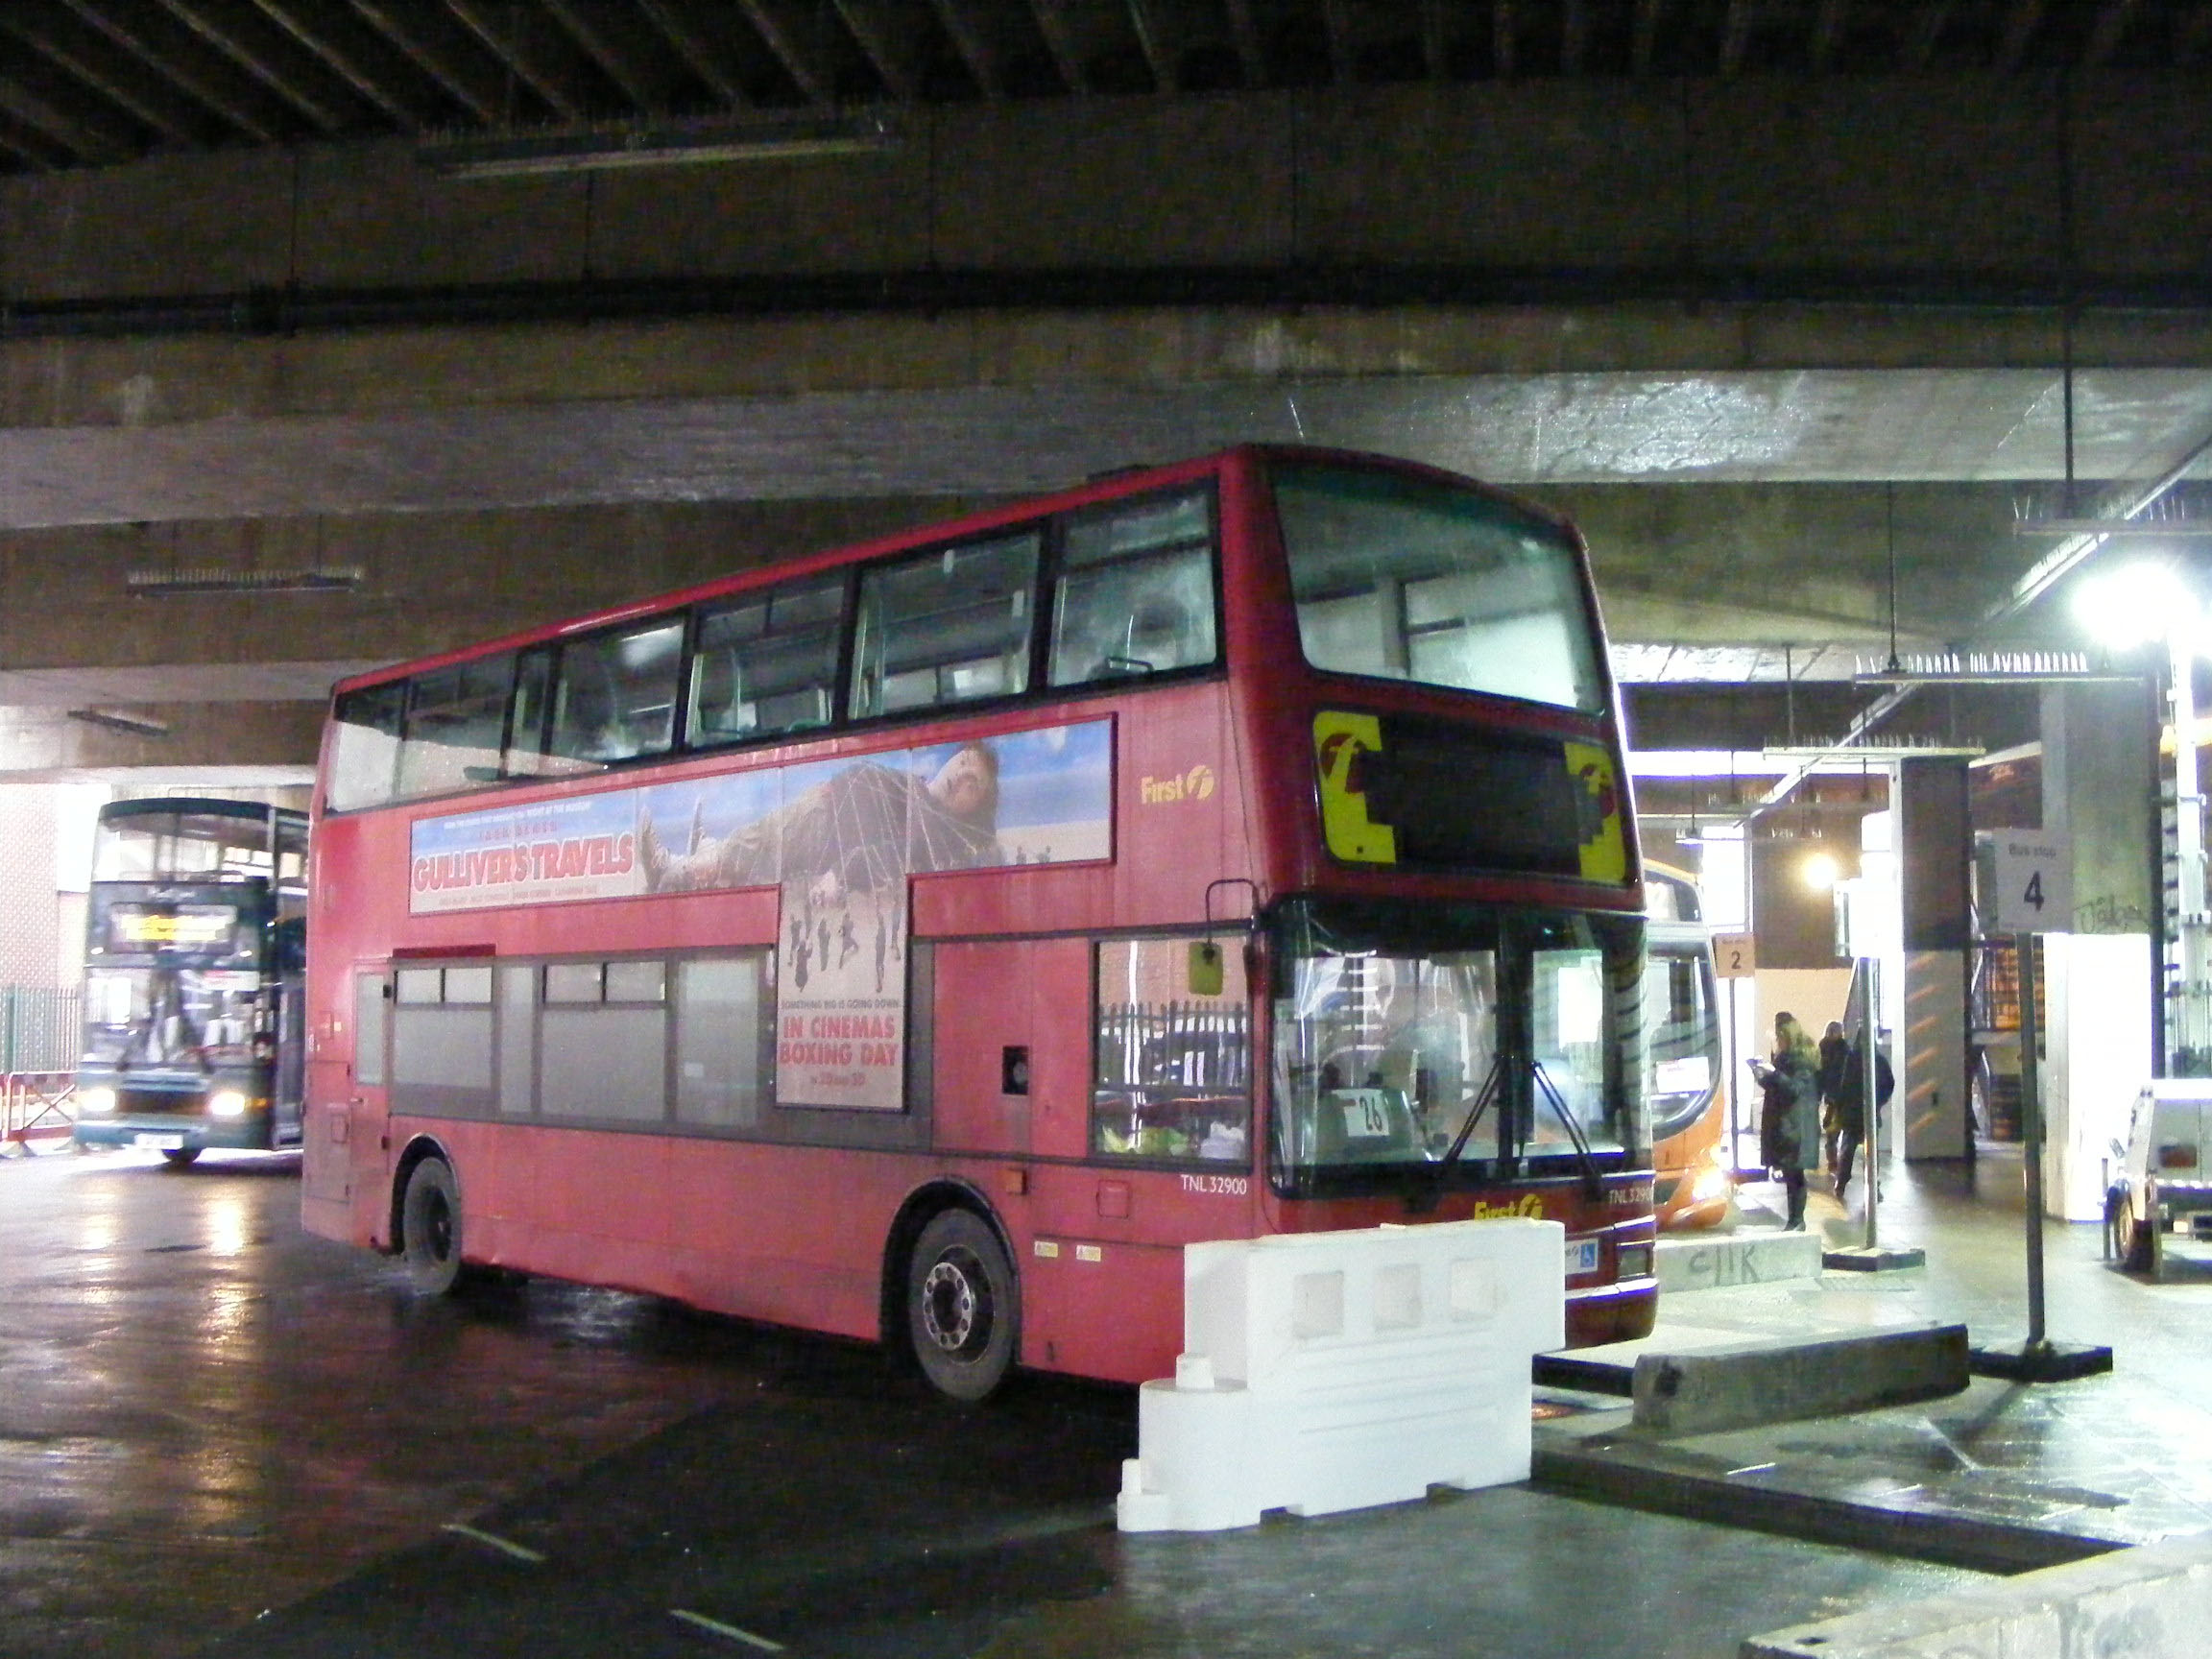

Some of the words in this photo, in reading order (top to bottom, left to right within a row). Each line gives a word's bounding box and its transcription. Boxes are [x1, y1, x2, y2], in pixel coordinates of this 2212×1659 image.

[1141, 772, 1184, 804] First
[528, 830, 635, 880] TRAVELS
[2008, 843, 2030, 857] Bus
[2023, 870, 2044, 911] 4
[1731, 950, 1742, 970] 2
[782, 1016, 804, 1038] IN
[811, 1015, 895, 1039] CINEMAS
[779, 1042, 853, 1066] BOXING
[860, 1043, 899, 1066] DAY
[1358, 1095, 1384, 1133] 26
[1181, 1174, 1207, 1192] TNL
[1210, 1177, 1247, 1195] 32900
